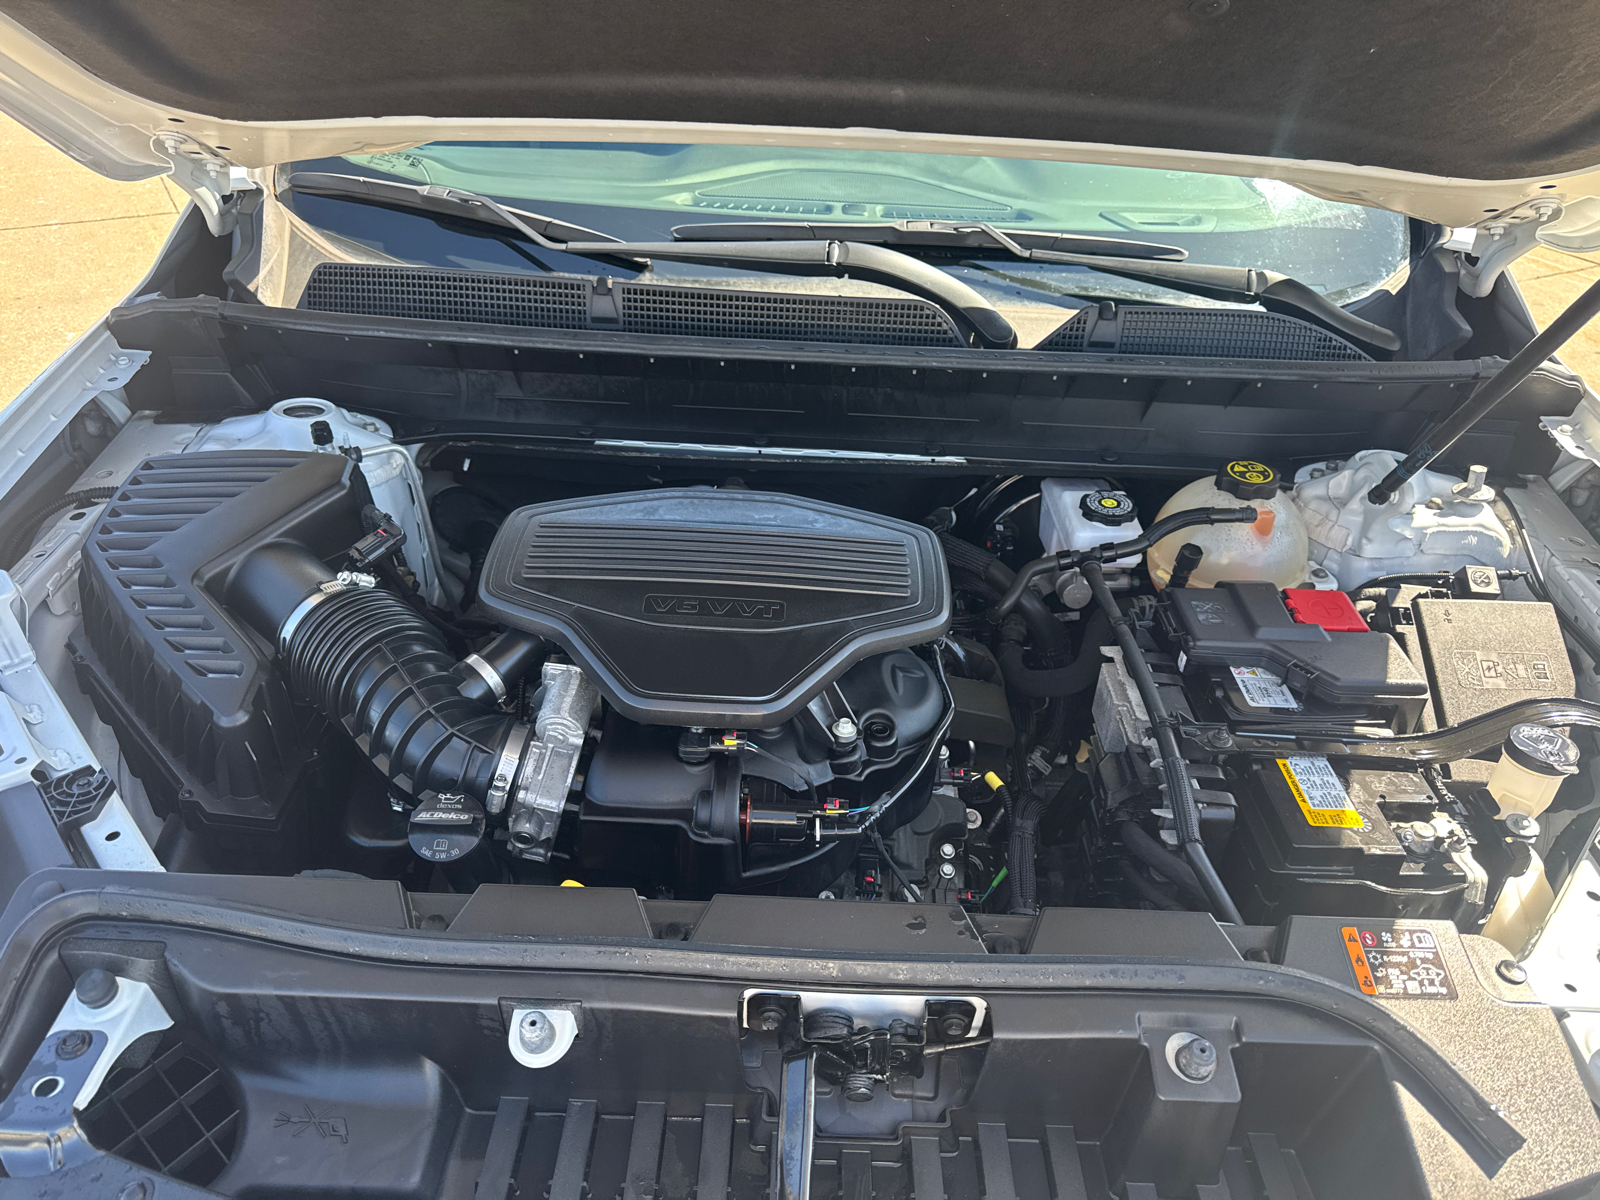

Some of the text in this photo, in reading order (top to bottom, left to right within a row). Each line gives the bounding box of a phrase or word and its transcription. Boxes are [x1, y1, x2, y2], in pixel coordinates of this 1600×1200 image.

[650, 598, 780, 617] V6 VVT
[416, 811, 469, 820] ACDelco
[420, 846, 460, 859] SAE 5W-30
